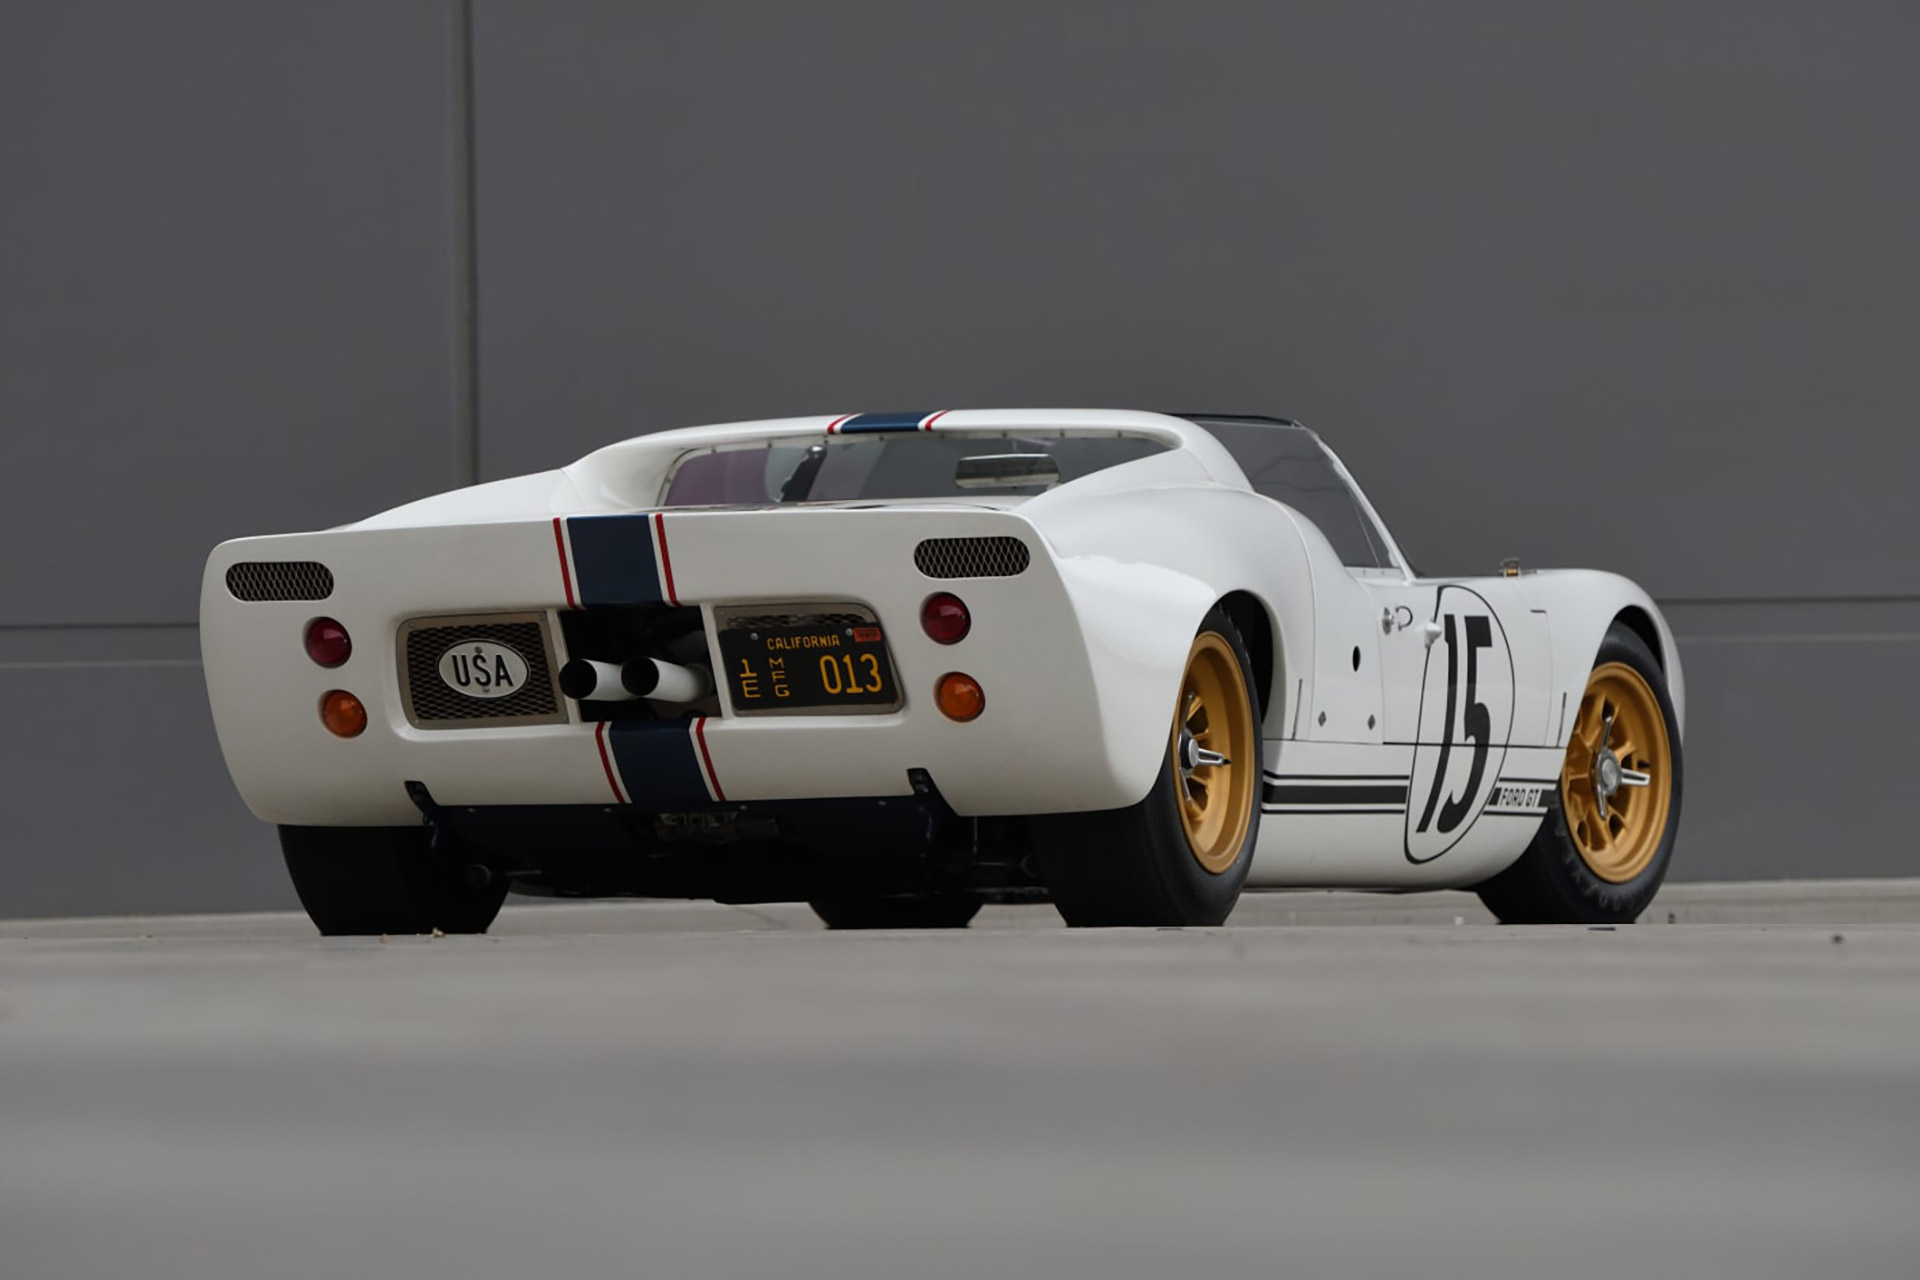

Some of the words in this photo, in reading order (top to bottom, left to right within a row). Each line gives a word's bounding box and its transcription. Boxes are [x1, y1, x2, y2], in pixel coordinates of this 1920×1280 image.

[766, 635, 840, 650] CALIFORNIA
[452, 654, 514, 687] USA
[769, 657, 790, 697] MFG
[819, 653, 882, 694] 013
[1416, 614, 1492, 833] 15
[1500, 787, 1526, 806] FORD
[1526, 789, 1540, 807] GT
